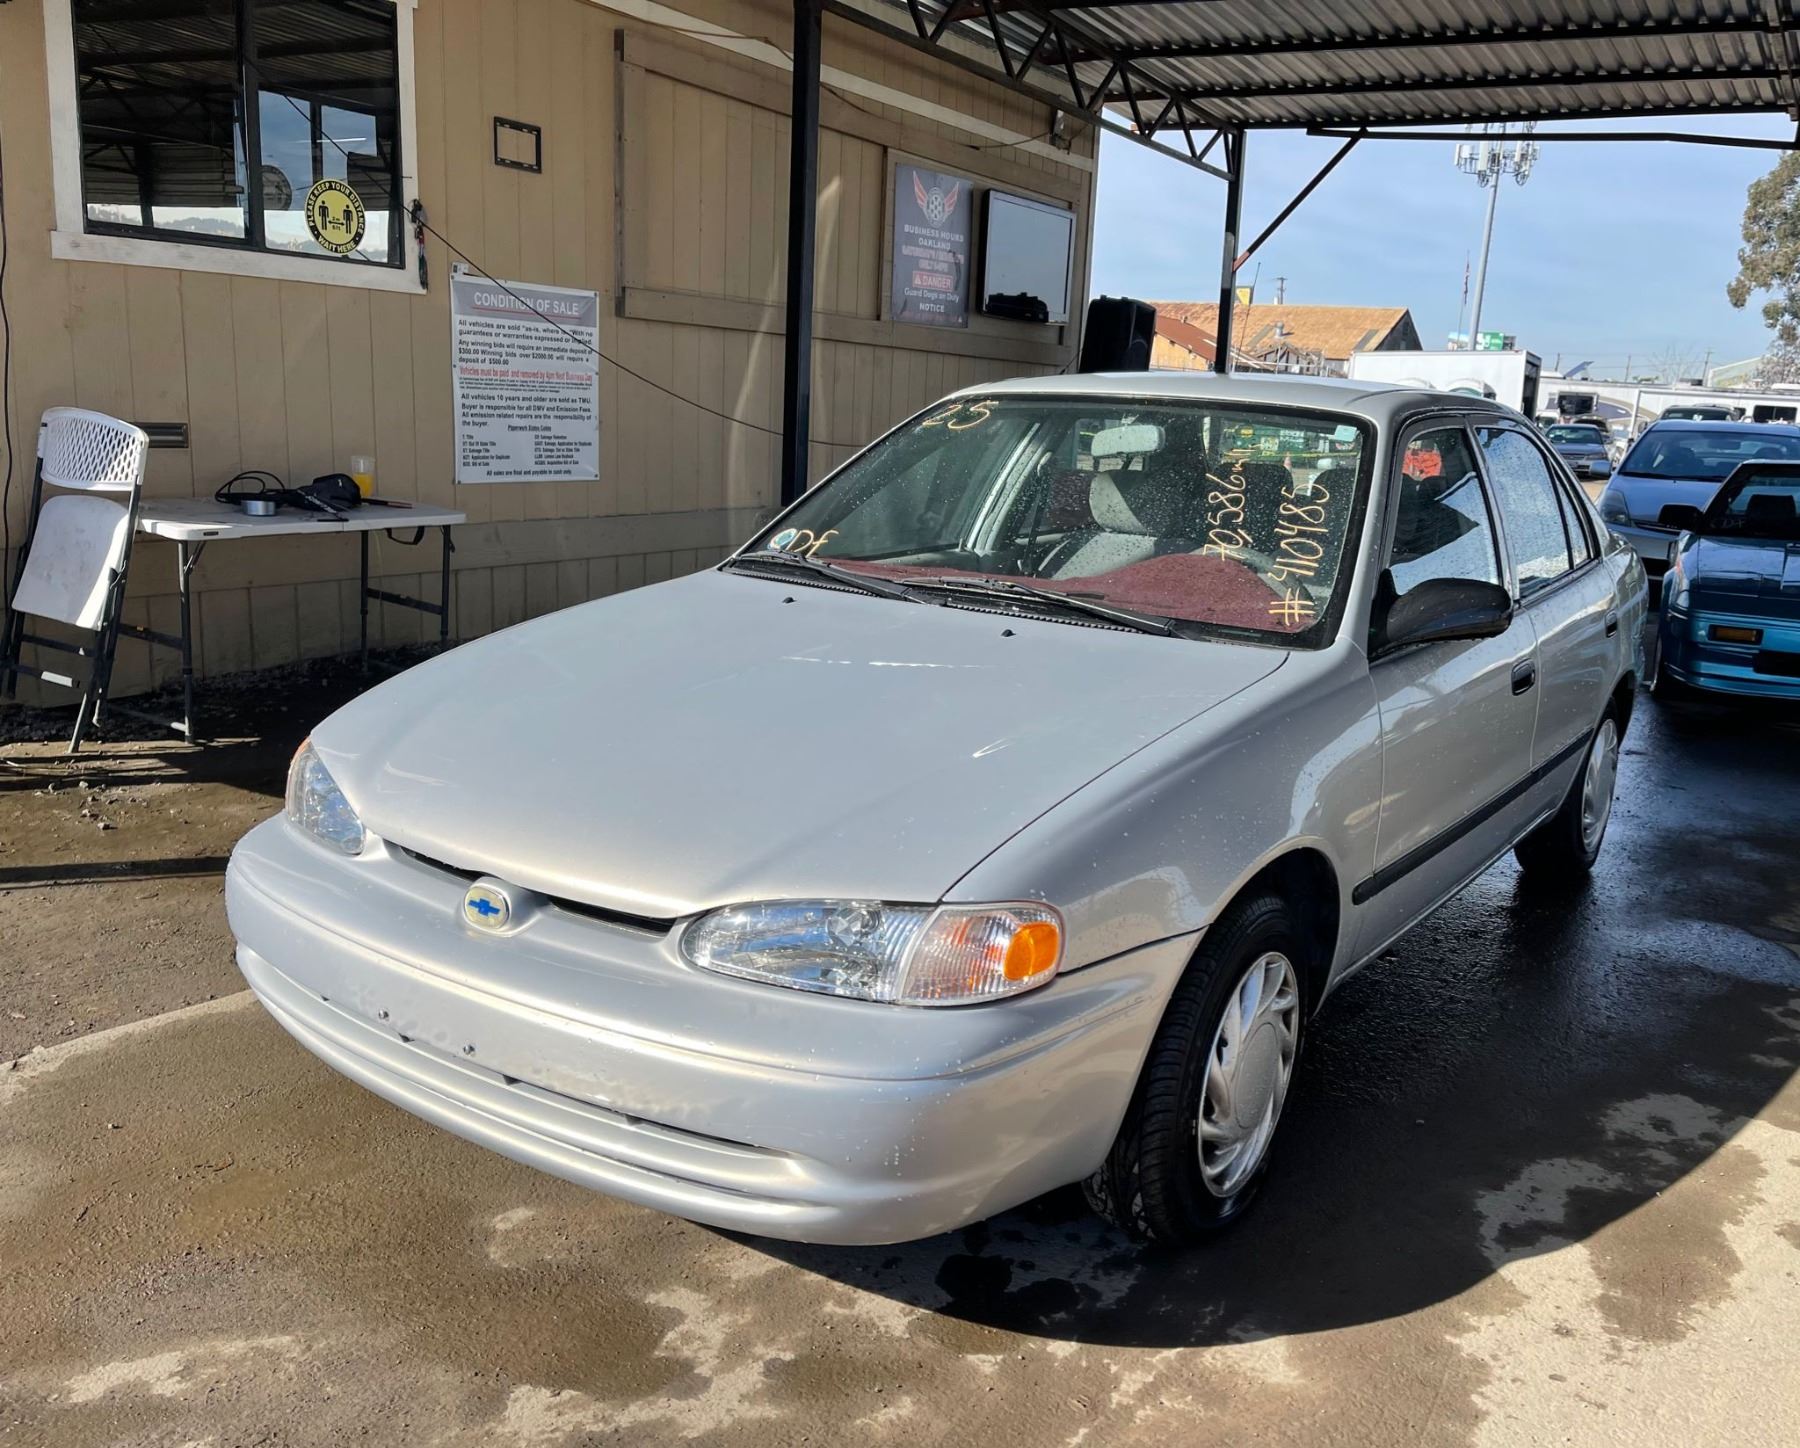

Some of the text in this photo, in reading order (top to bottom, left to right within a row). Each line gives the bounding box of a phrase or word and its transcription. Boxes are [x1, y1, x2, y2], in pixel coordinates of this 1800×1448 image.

[307, 182, 365, 233] PLEASE KEEP YOUR DISTANCE
[904, 224, 964, 242] BUSINESS HOURS
[318, 235, 356, 253] WAIT HERE
[919, 238, 951, 250] OAKLAND
[922, 275, 951, 288] DANGER
[904, 288, 922, 296] Guard
[923, 290, 937, 300] Dogs
[947, 293, 959, 303] Duty
[474, 292, 579, 315] CONDITION OF SALE
[920, 303, 945, 313] NOTICE
[469, 320, 494, 329] vehicles
[481, 349, 503, 357] Winning
[460, 366, 479, 376] Vehicles
[499, 369, 510, 378] paid
[539, 370, 545, 379] by
[922, 401, 999, 429] 25
[1203, 473, 1254, 561] 70,586
